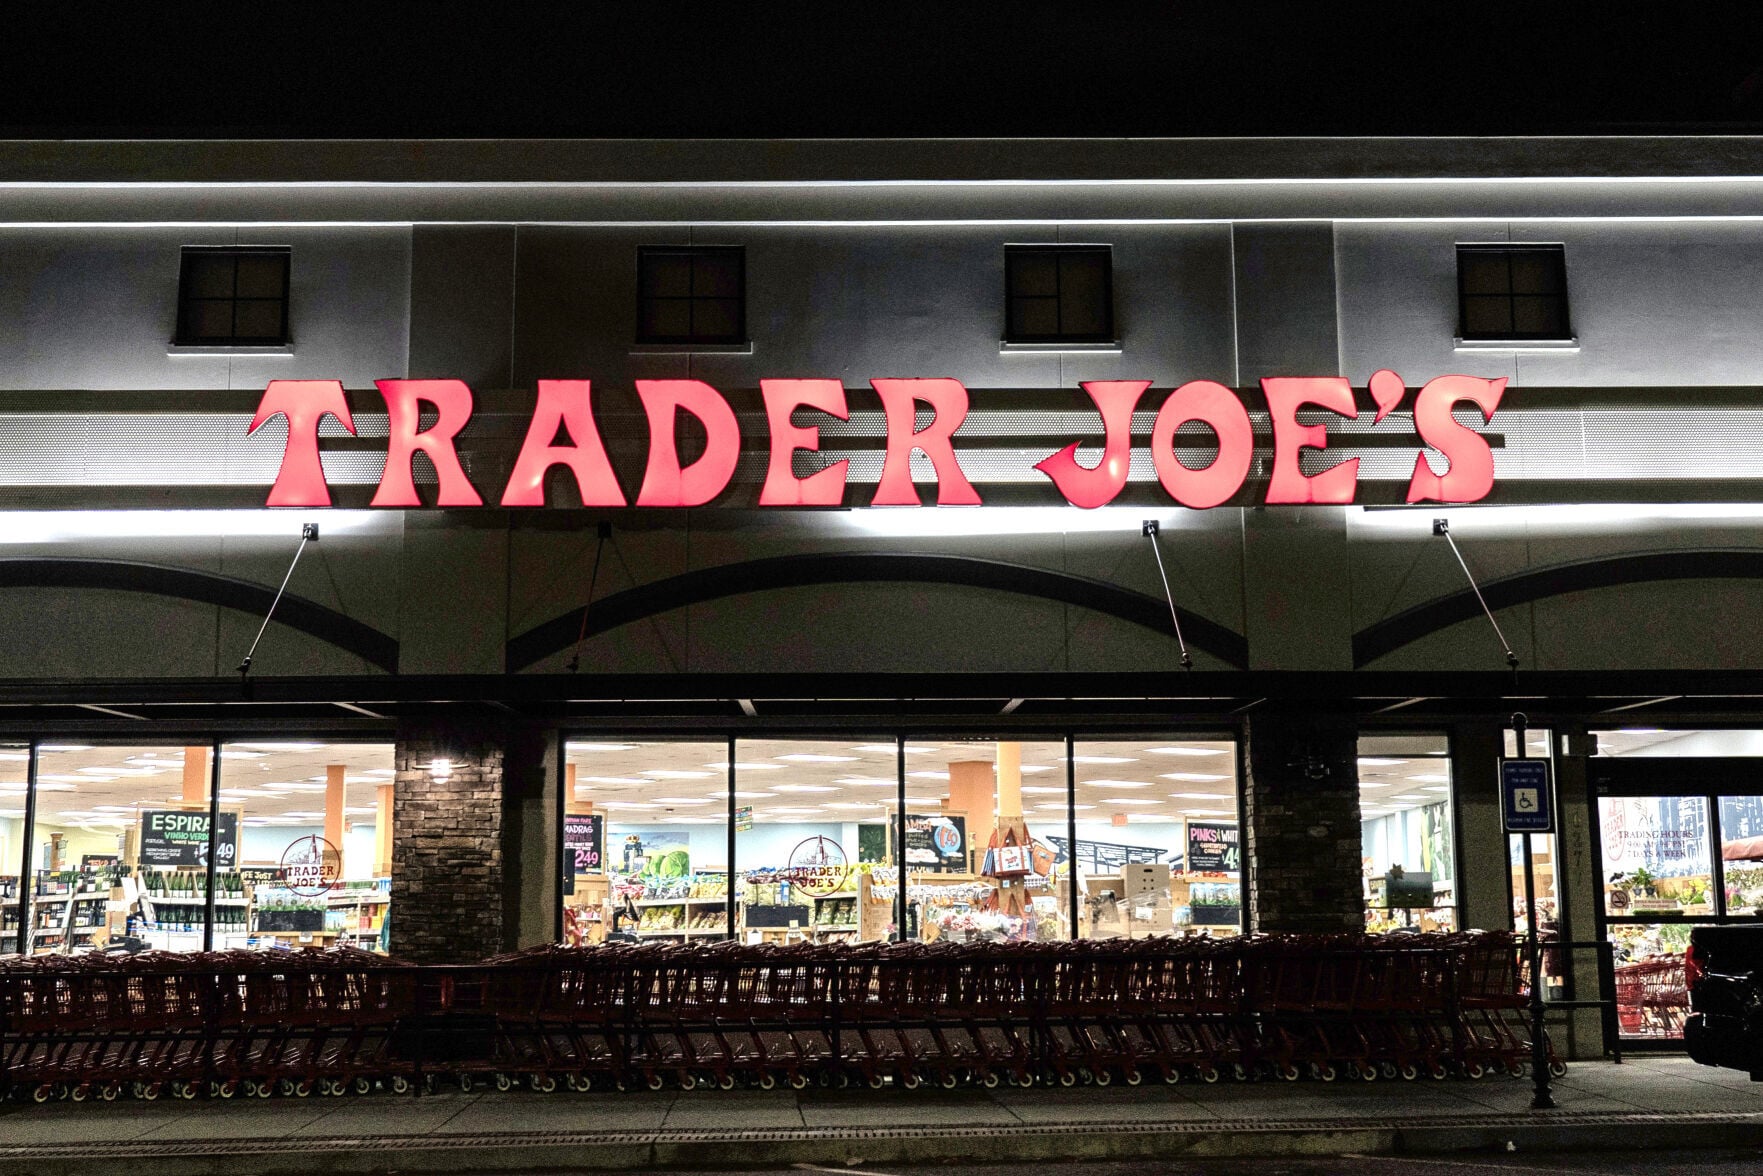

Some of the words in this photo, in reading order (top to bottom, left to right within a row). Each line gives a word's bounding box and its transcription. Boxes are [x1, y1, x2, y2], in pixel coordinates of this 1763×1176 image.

[246, 377, 982, 508] TRADER
[1033, 368, 1509, 510] JOE'S
[151, 814, 226, 833] ESPIRA
[164, 831, 188, 840] VINHO
[190, 832, 210, 841] VERD
[1190, 828, 1217, 842] PINKS
[1221, 830, 1239, 842] WHIT
[1619, 830, 1660, 839] TRADING
[1660, 830, 1694, 839] HOURS
[1663, 849, 1686, 857] WEEK
[287, 865, 335, 877] TRADER
[793, 866, 842, 876] TRADER
[293, 877, 328, 887] JOE'S
[801, 878, 836, 888] JOE'S
